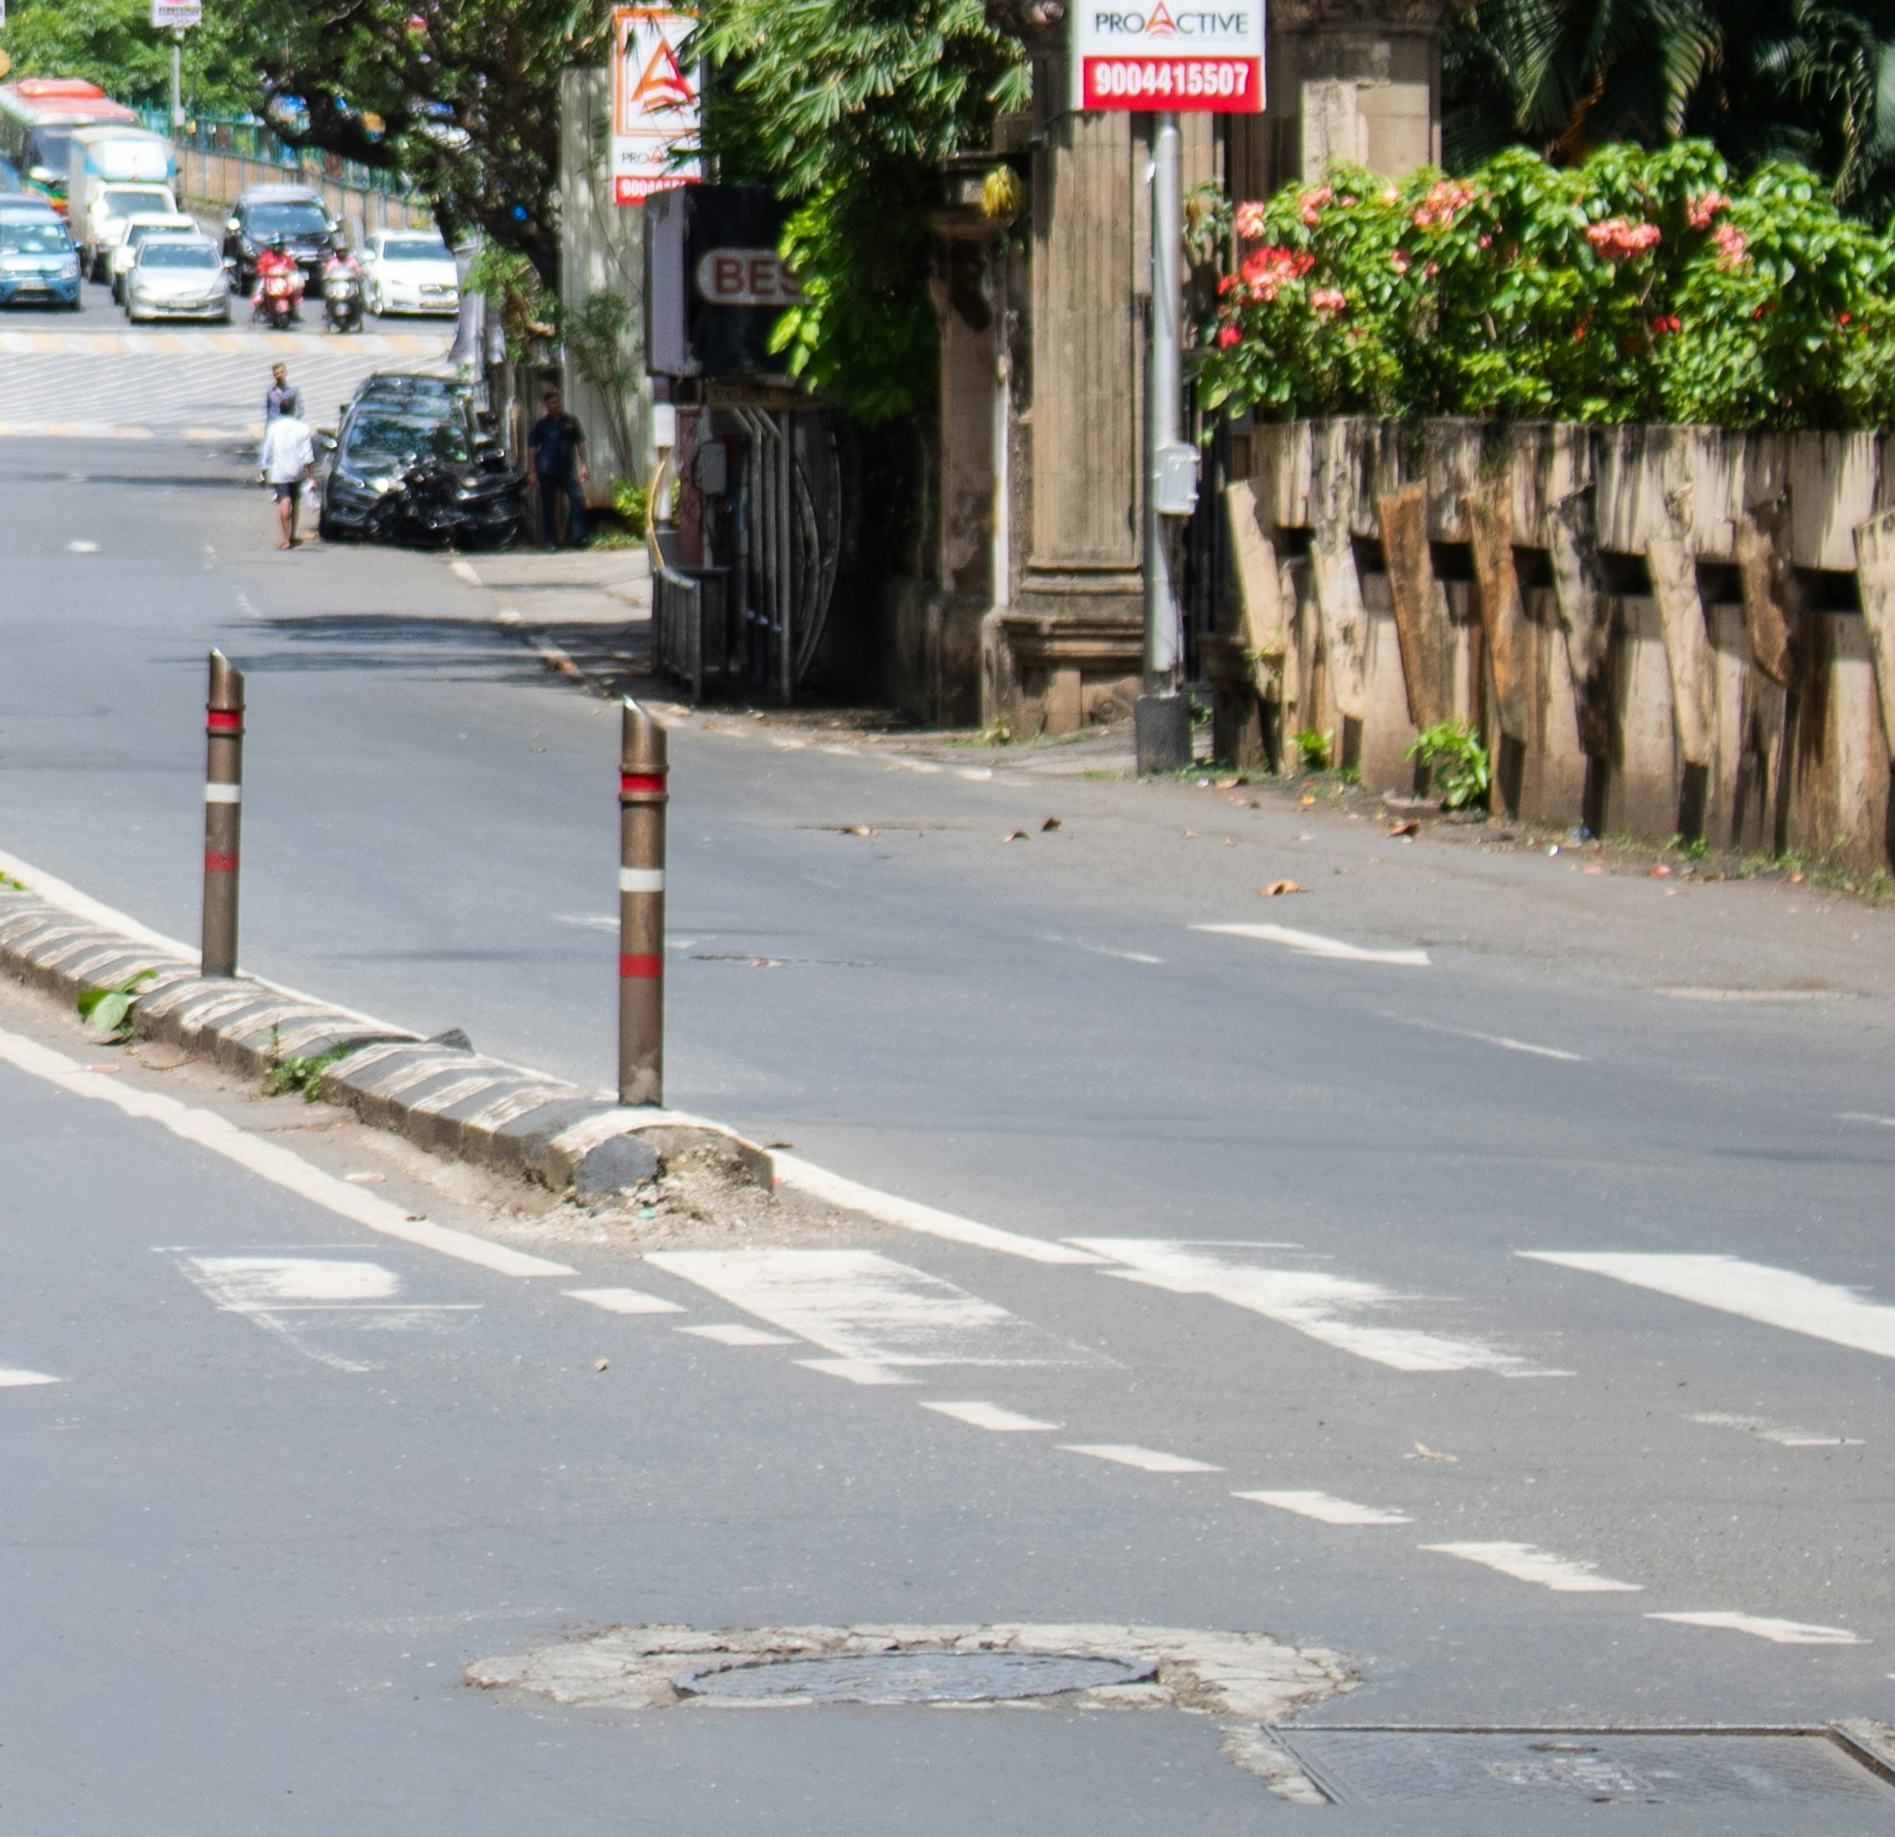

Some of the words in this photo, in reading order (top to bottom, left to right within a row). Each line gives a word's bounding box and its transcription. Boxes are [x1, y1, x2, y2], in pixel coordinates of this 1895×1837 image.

[1095, 0, 1249, 38] PROACTIVE
[1095, 63, 1249, 96] 9004415507
[714, 258, 803, 296] BES
